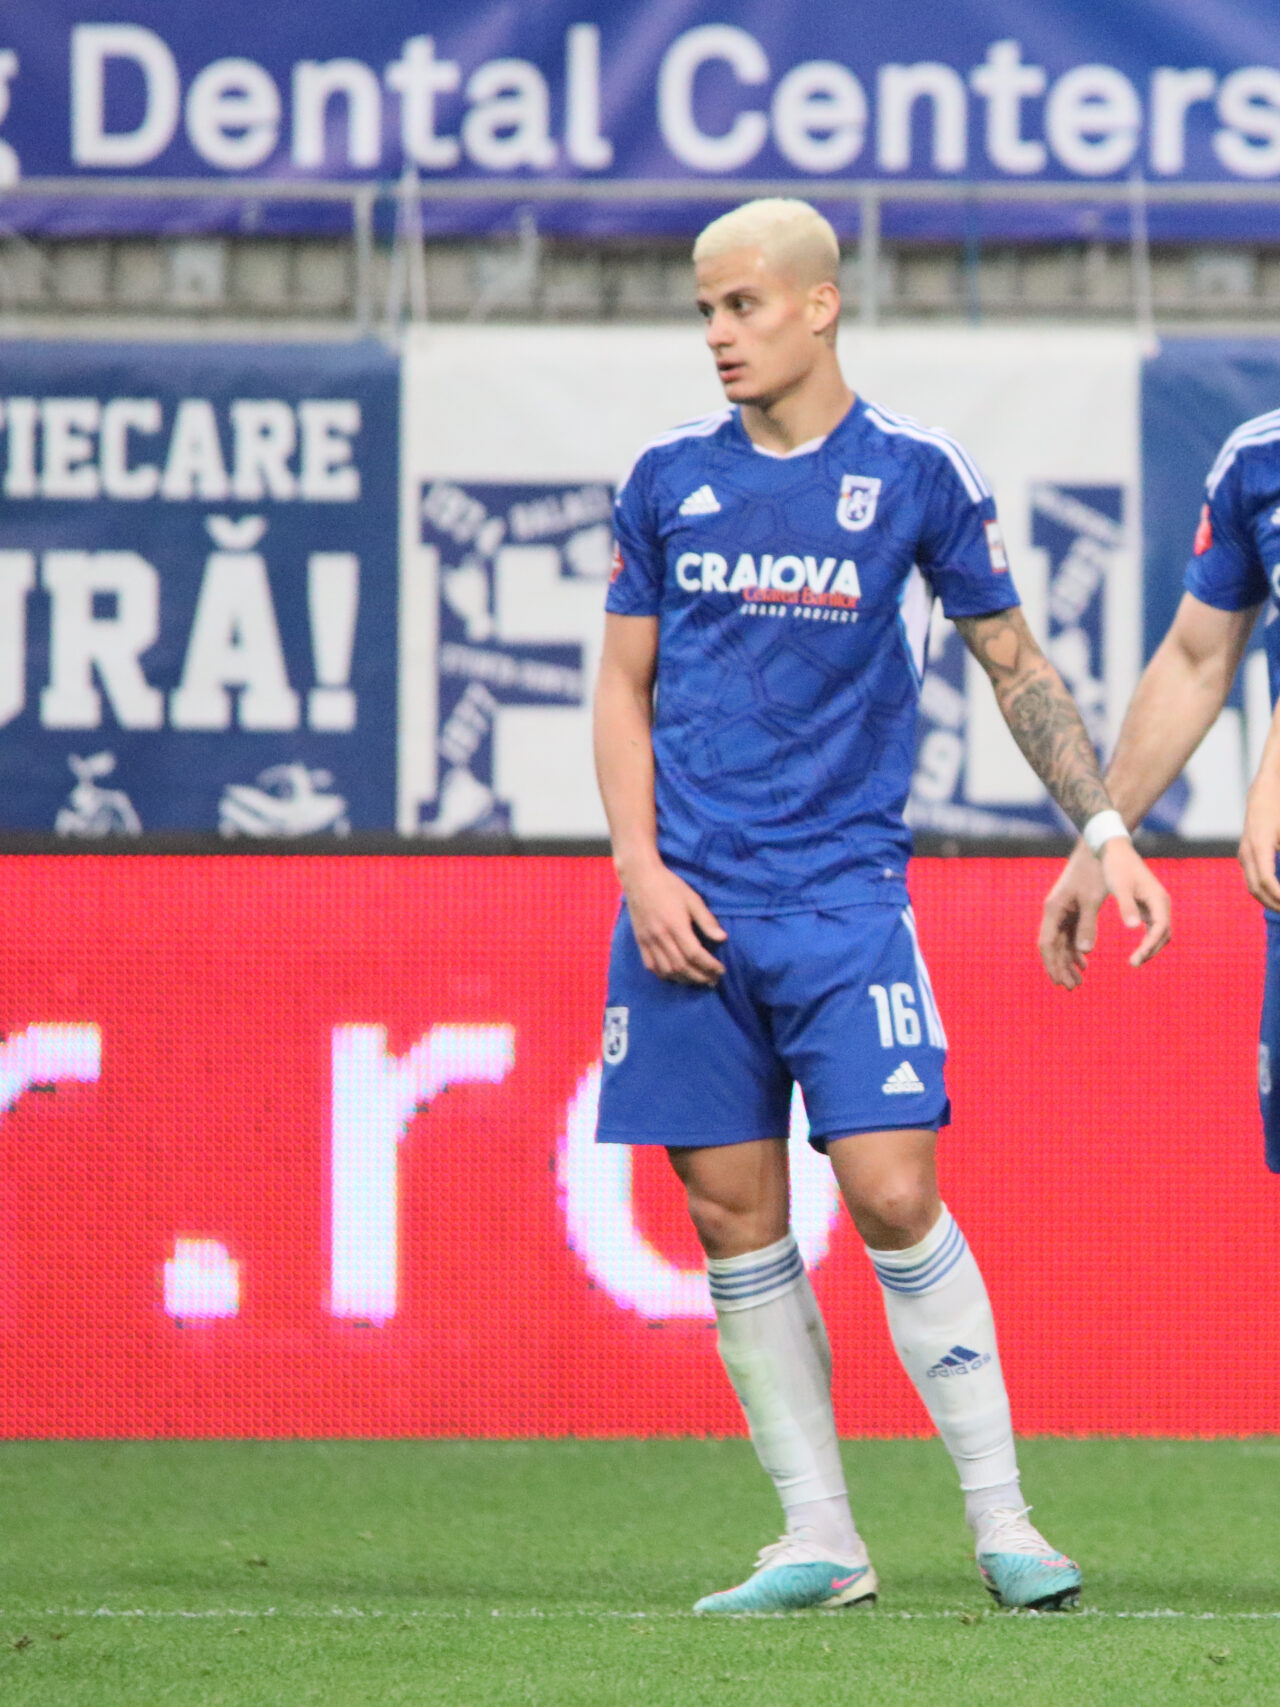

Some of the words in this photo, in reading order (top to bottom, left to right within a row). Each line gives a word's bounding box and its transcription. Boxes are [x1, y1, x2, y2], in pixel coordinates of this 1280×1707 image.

[69, 21, 614, 170] Dental
[0, 397, 362, 502] IECARE
[675, 552, 862, 597] CRAIOVA
[868, 982, 921, 1049] 16
[926, 1352, 992, 1379] adidas
